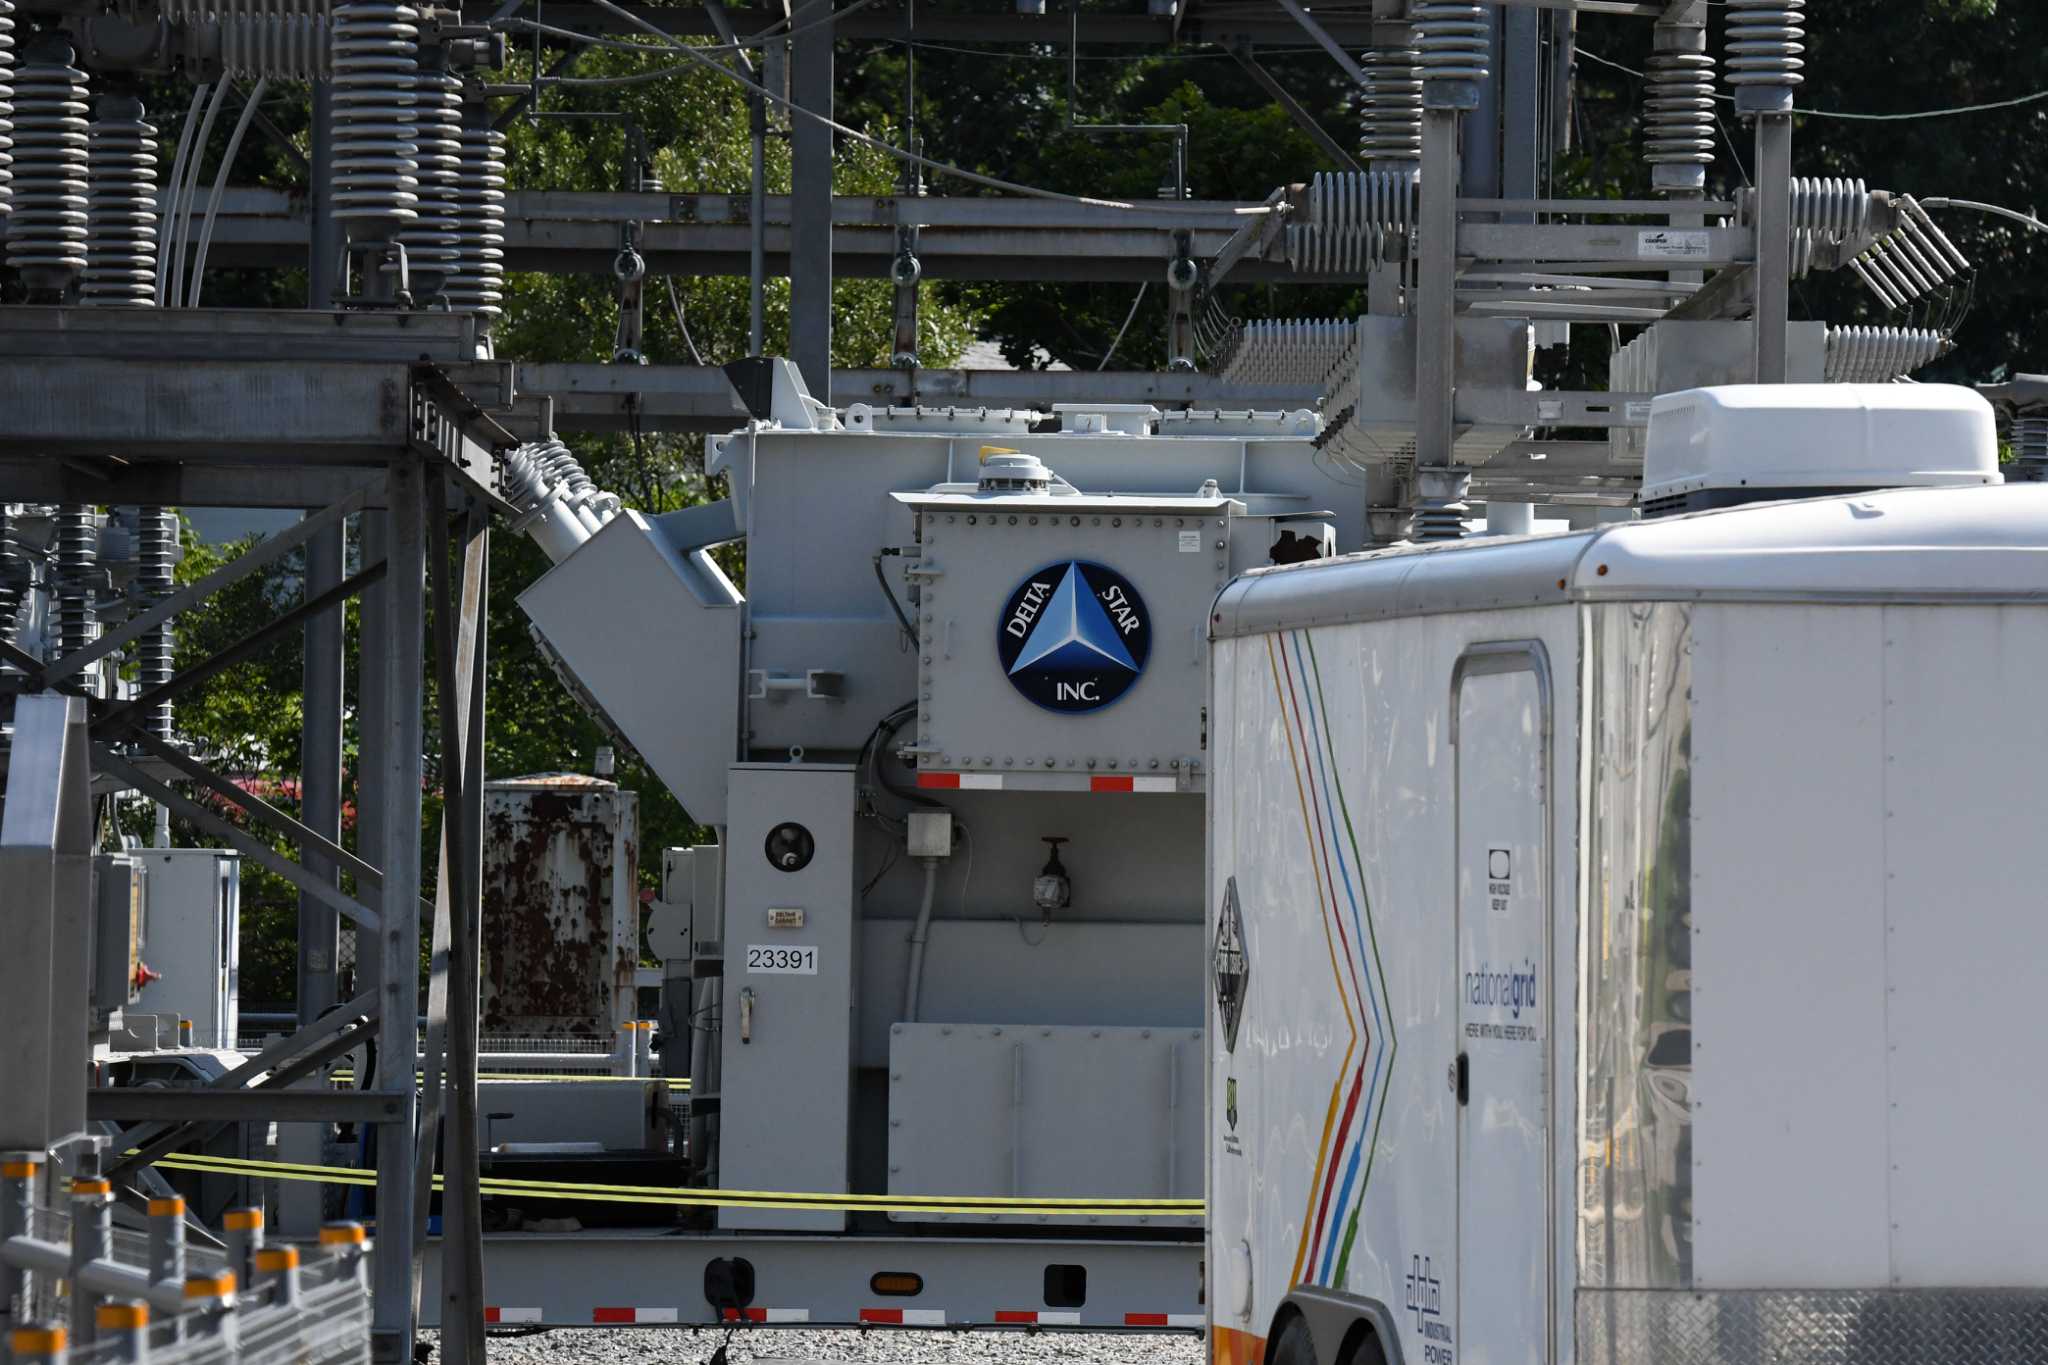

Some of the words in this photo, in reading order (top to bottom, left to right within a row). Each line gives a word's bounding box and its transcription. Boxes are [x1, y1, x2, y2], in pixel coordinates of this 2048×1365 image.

[1006, 582, 1051, 638] DELTA
[1102, 585, 1140, 635] STAR
[1057, 682, 1100, 701] INC.
[748, 949, 813, 969] 23391
[1465, 957, 1536, 1019] nationalgrid
[1424, 1344, 1453, 1365] POWER
